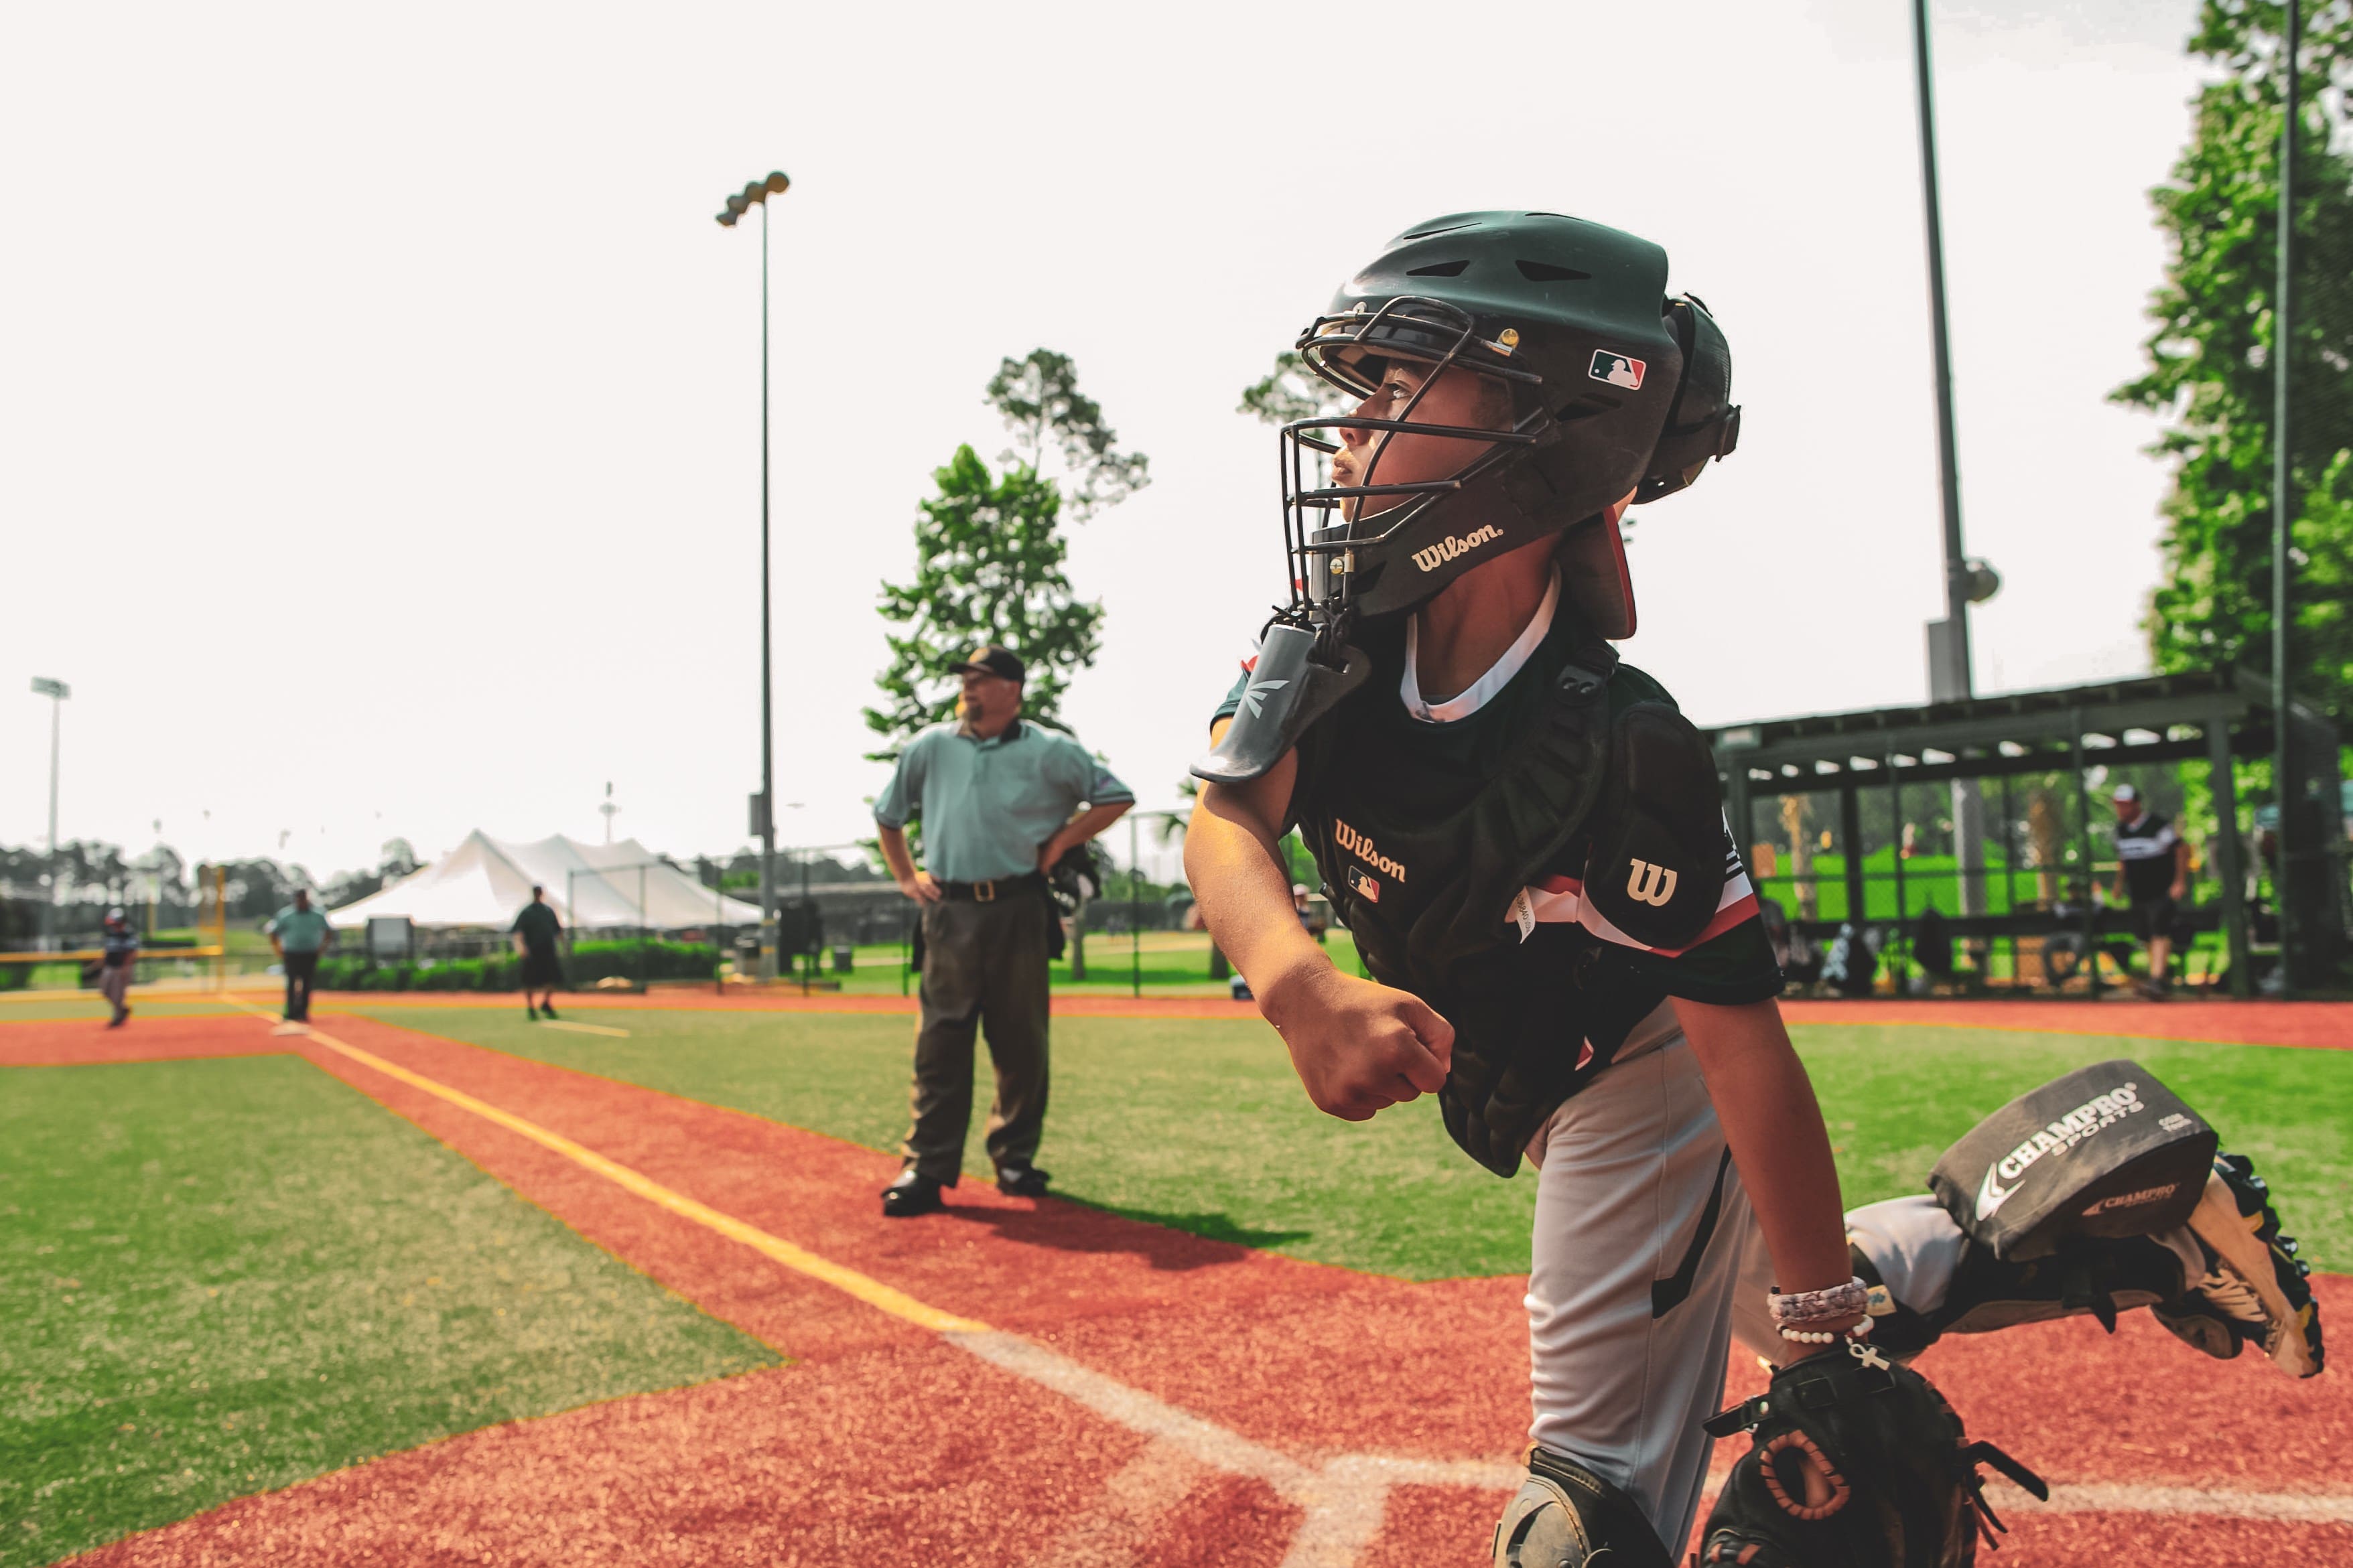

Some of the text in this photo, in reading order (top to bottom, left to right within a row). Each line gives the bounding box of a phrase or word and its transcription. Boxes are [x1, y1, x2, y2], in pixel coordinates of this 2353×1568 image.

[1412, 524, 1498, 572] Wilson
[1336, 818, 1405, 883] Wilson
[1627, 858, 1677, 906] W
[1998, 1087, 2137, 1179] CHAMPRO
